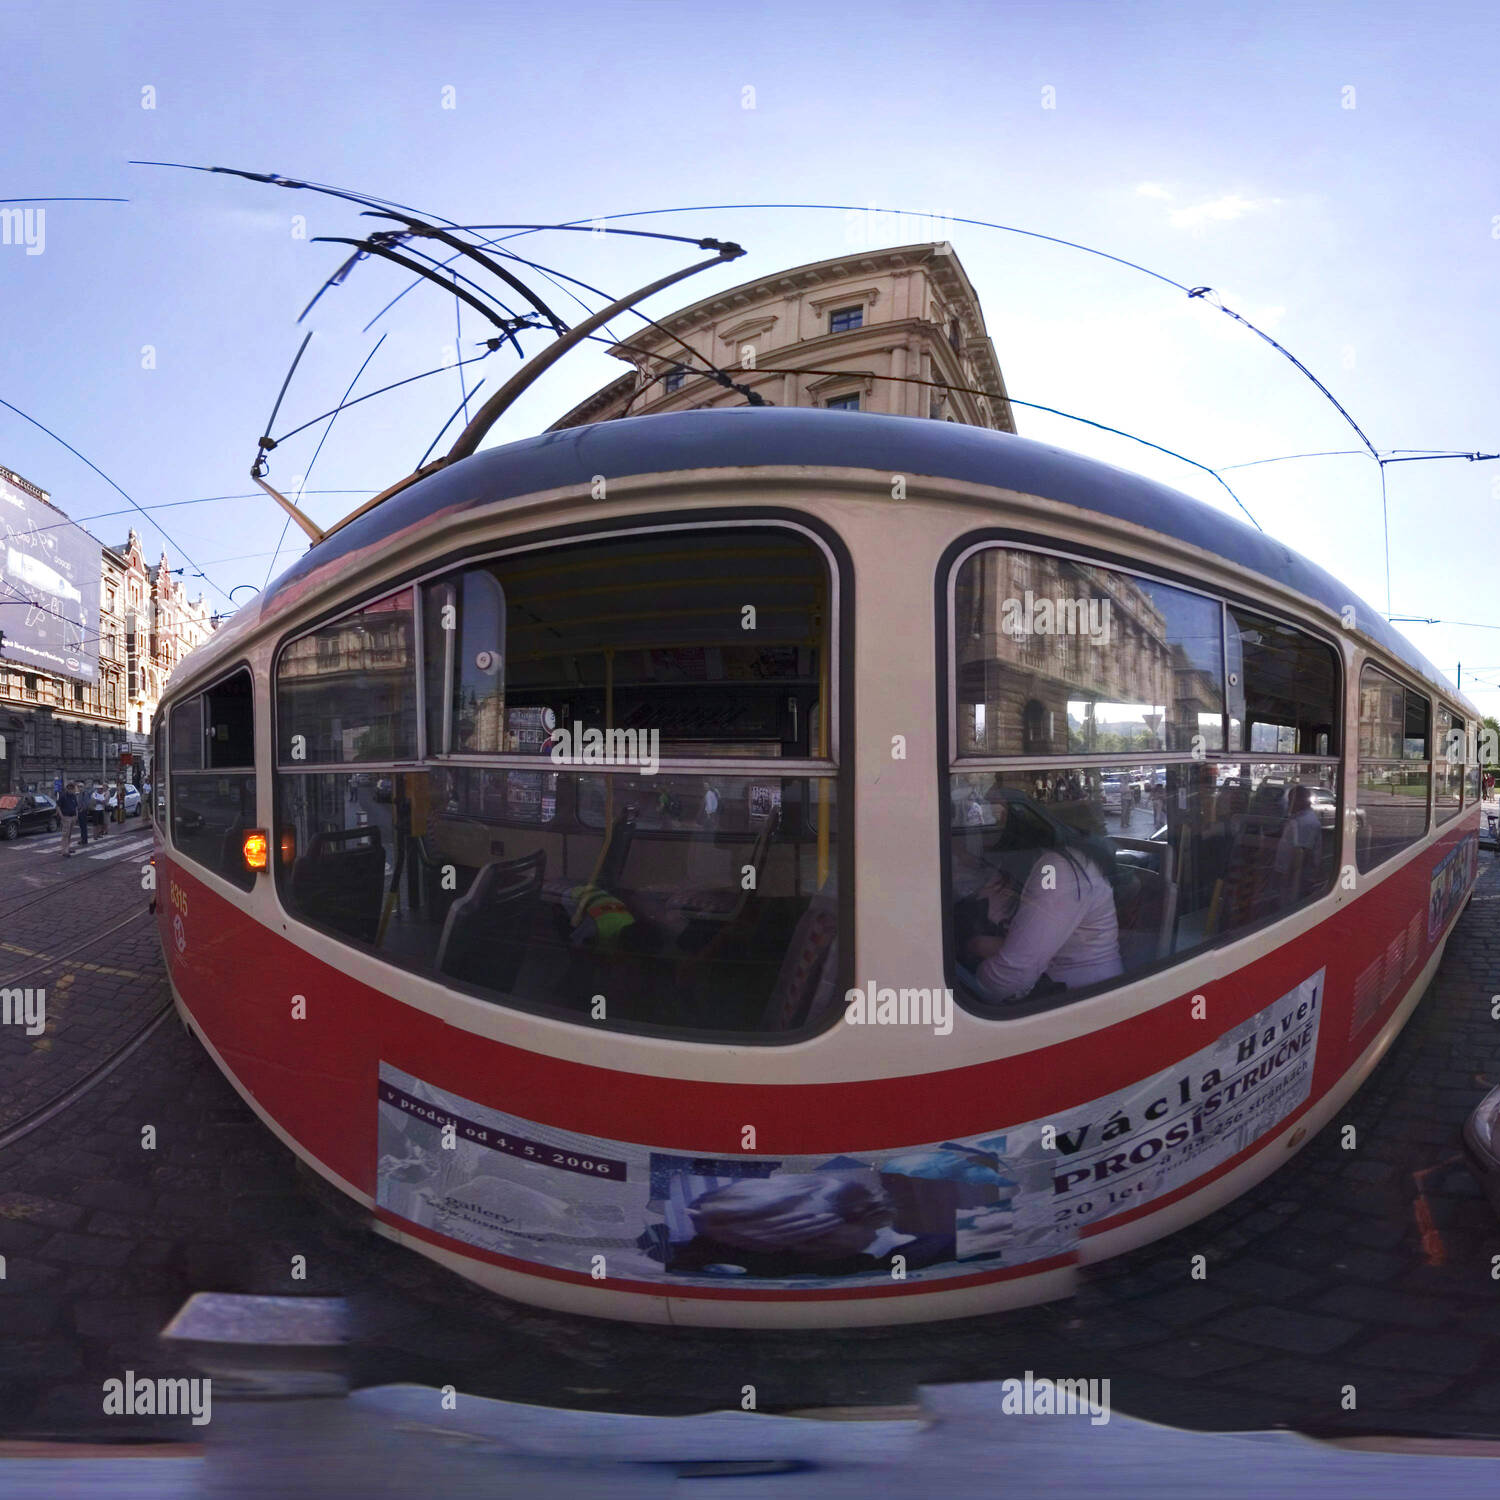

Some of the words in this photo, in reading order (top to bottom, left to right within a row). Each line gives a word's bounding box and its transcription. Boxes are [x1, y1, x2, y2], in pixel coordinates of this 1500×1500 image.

[1235, 985, 1318, 1066] Havel
[465, 1127, 488, 1141] od
[496, 1137, 515, 1150] 4.
[524, 1145, 543, 1158] 5.
[552, 1153, 611, 1174] 2006
[1054, 1201, 1093, 1222] 20
[1108, 1181, 1144, 1203] let
[1213, 1111, 1243, 1135] 256
[445, 1196, 515, 1224] gallery
